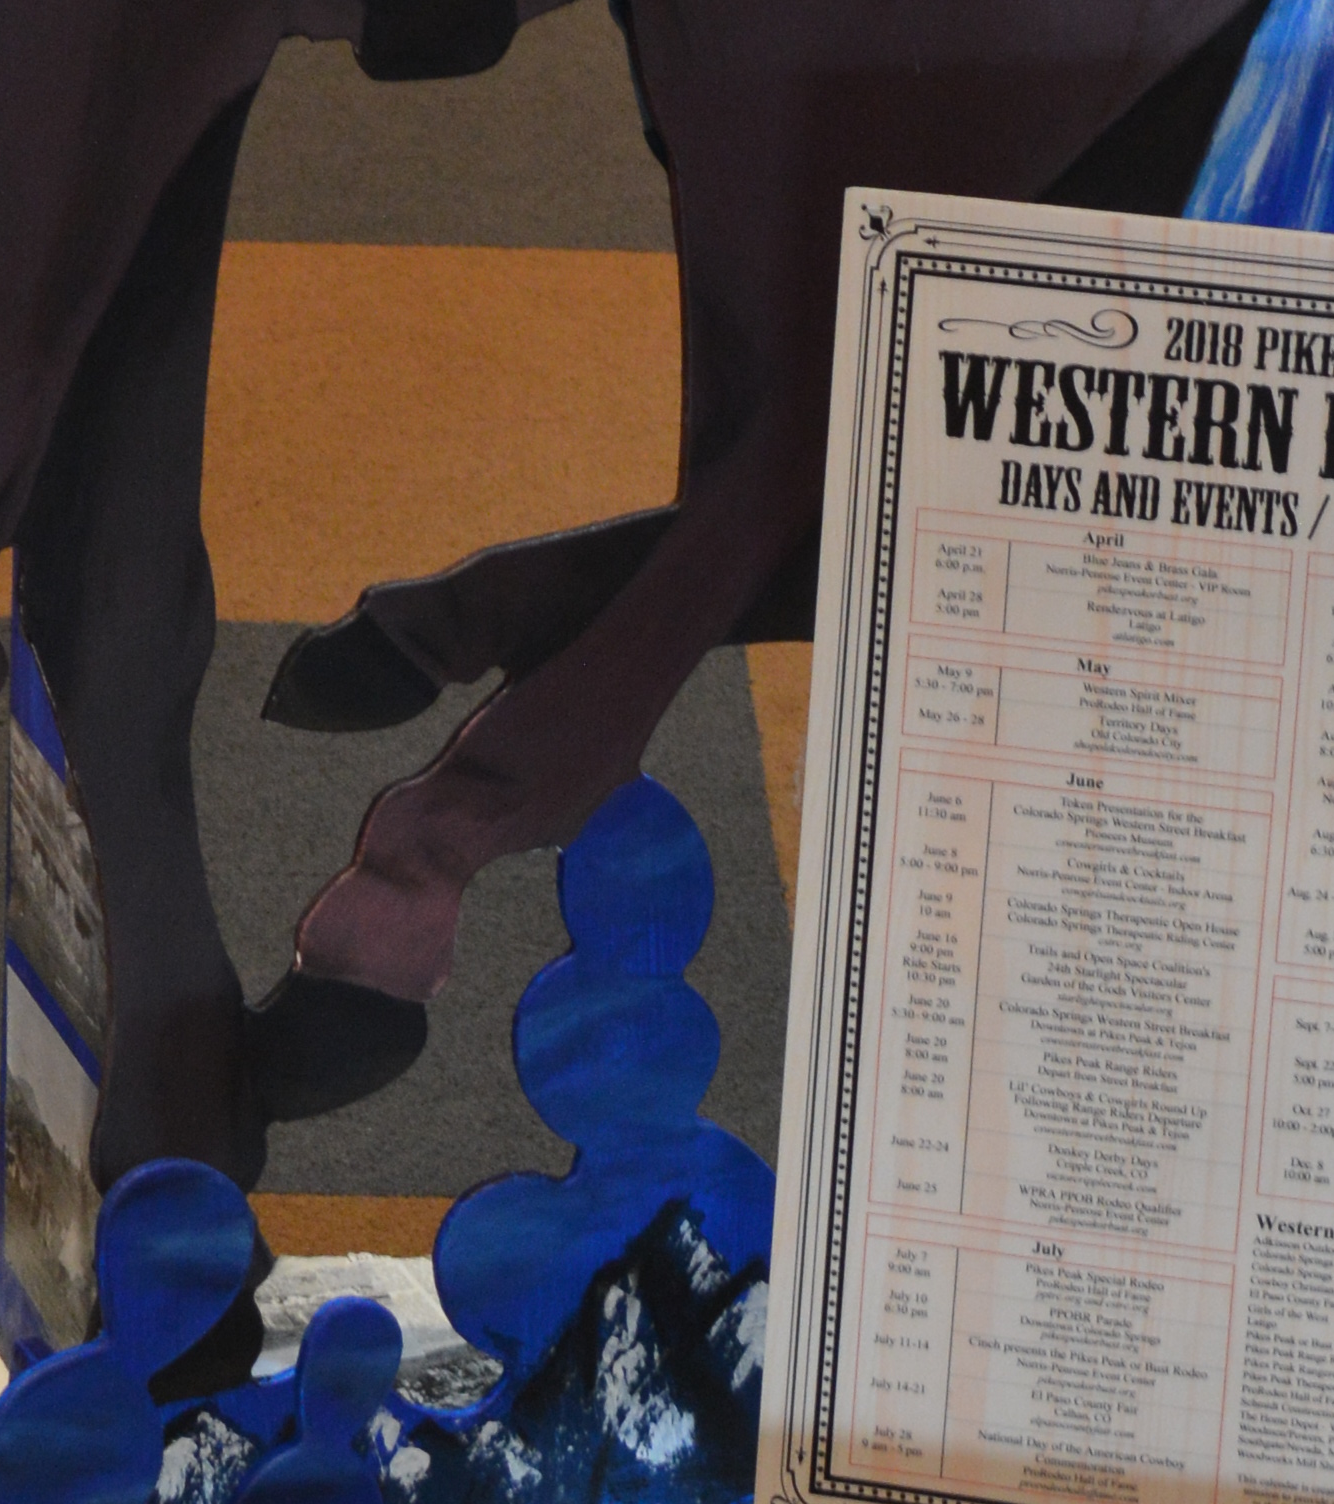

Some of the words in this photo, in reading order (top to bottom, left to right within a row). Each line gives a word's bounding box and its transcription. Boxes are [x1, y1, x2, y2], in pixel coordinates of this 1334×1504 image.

[1163, 316, 1244, 368] 2018
[937, 349, 1300, 475] WESTERN
[997, 458, 1083, 514] DAYS
[1089, 469, 1161, 522] AND
[1169, 477, 1300, 538] EVENTS
[937, 542, 967, 558] April
[968, 545, 983, 558] 21
[1082, 530, 1125, 549] April
[936, 587, 967, 603] April
[968, 589, 984, 604] 28
[1085, 599, 1154, 619] Rendezvous
[1154, 610, 1167, 621] at
[1168, 609, 1207, 627] Latigo
[1076, 657, 1110, 677] May
[1081, 681, 1127, 698] Western
[1129, 687, 1161, 703] Spirit
[1162, 690, 1197, 707] Mixer
[1065, 771, 1104, 790] June
[1006, 896, 1059, 914] Colorado
[1059, 903, 1103, 922] Springs
[1105, 908, 1170, 929] Therapeutic
[1171, 917, 1203, 934] Open
[1204, 921, 1241, 937] House
[1255, 1212, 1334, 1240] Western
[1031, 1240, 1064, 1261] July
[967, 1334, 1001, 1351] Cinch
[1002, 1342, 1048, 1358] presents
[1048, 1346, 1067, 1361] the
[1069, 1349, 1100, 1366] Pikes
[1100, 1354, 1127, 1370] Peak
[1128, 1361, 1142, 1372] or
[1144, 1360, 1170, 1376] Bust
[1171, 1364, 1209, 1380] Rodeo
